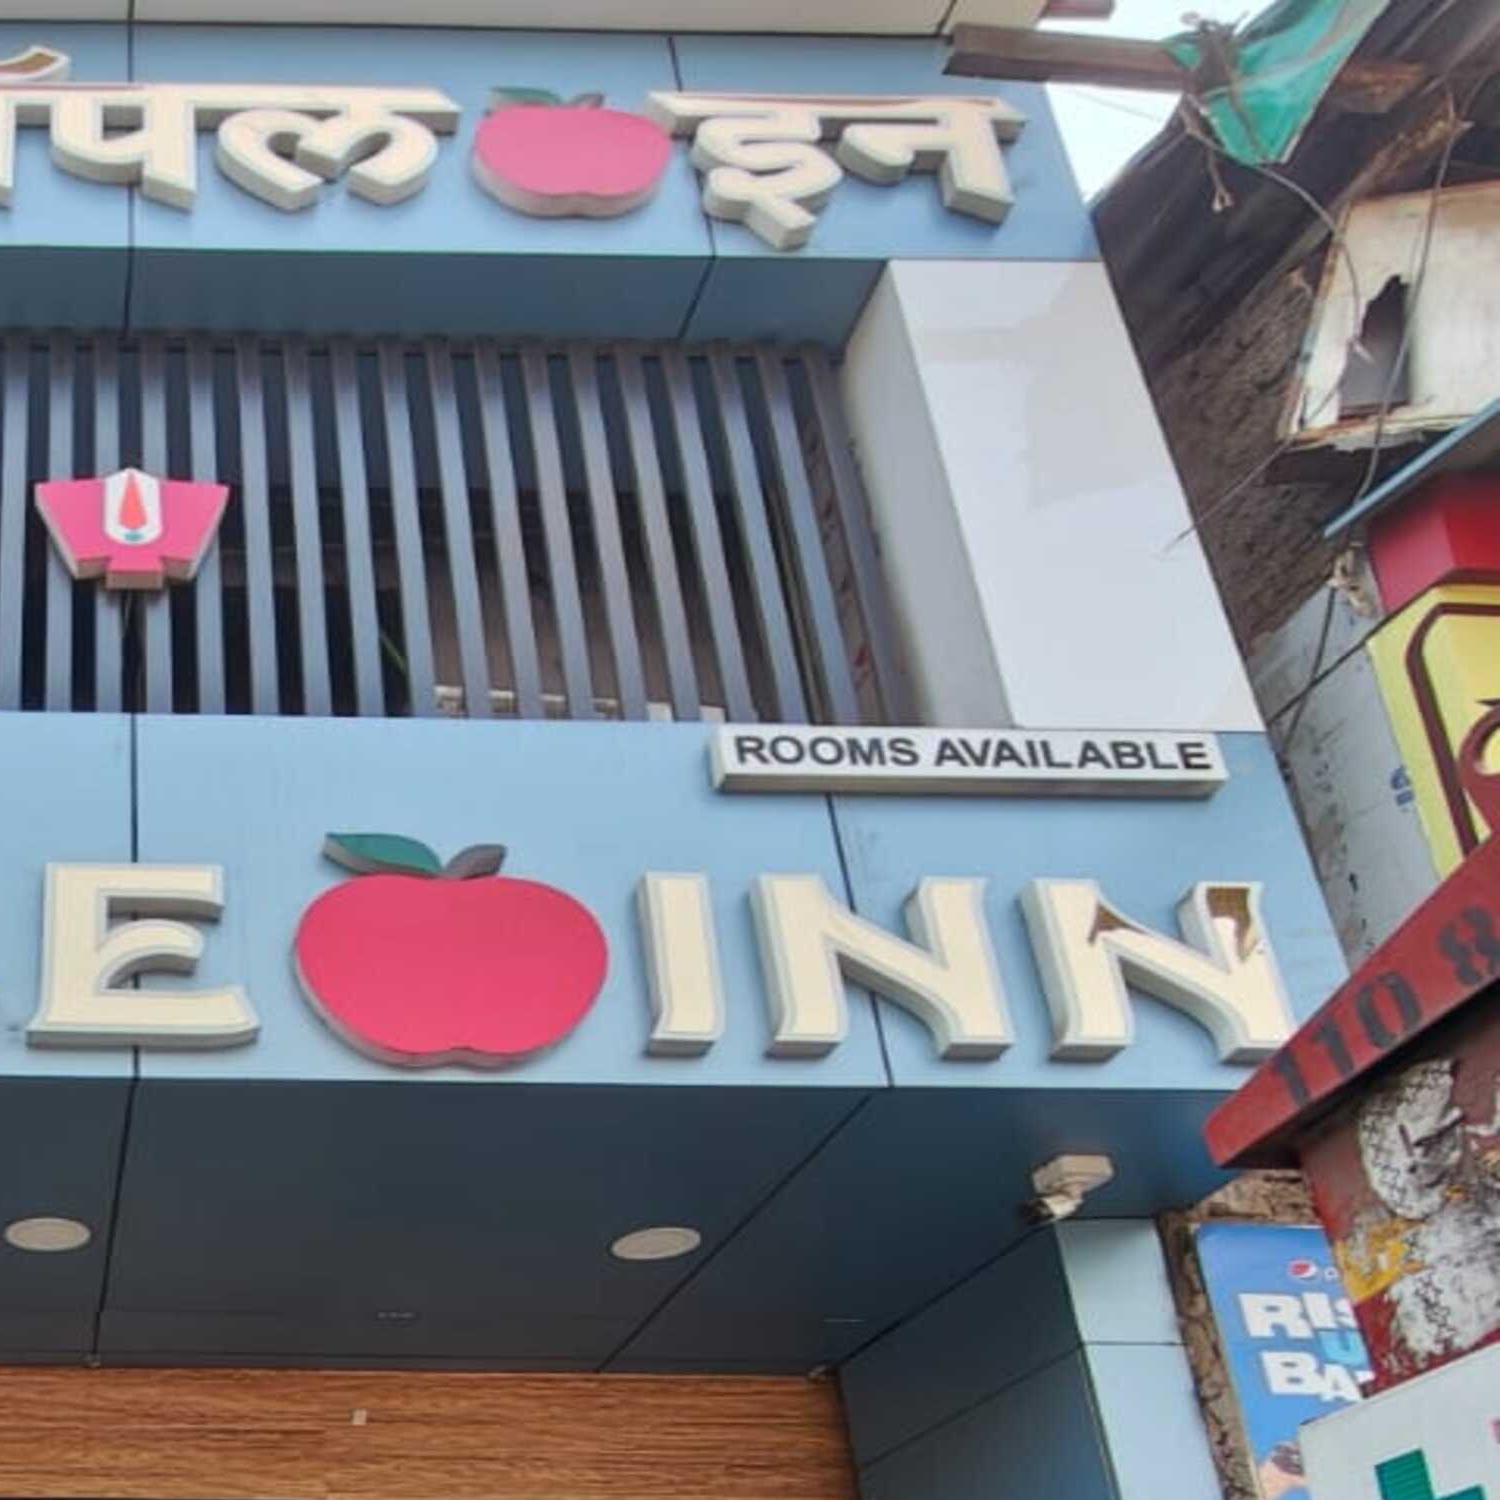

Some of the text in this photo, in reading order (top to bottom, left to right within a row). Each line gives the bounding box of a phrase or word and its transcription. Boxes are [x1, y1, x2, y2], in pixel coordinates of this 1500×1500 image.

[647, 90, 1029, 250] इन
[735, 735, 1213, 771] ROOMS AVAILABLE
[634, 870, 1302, 1063] INN
